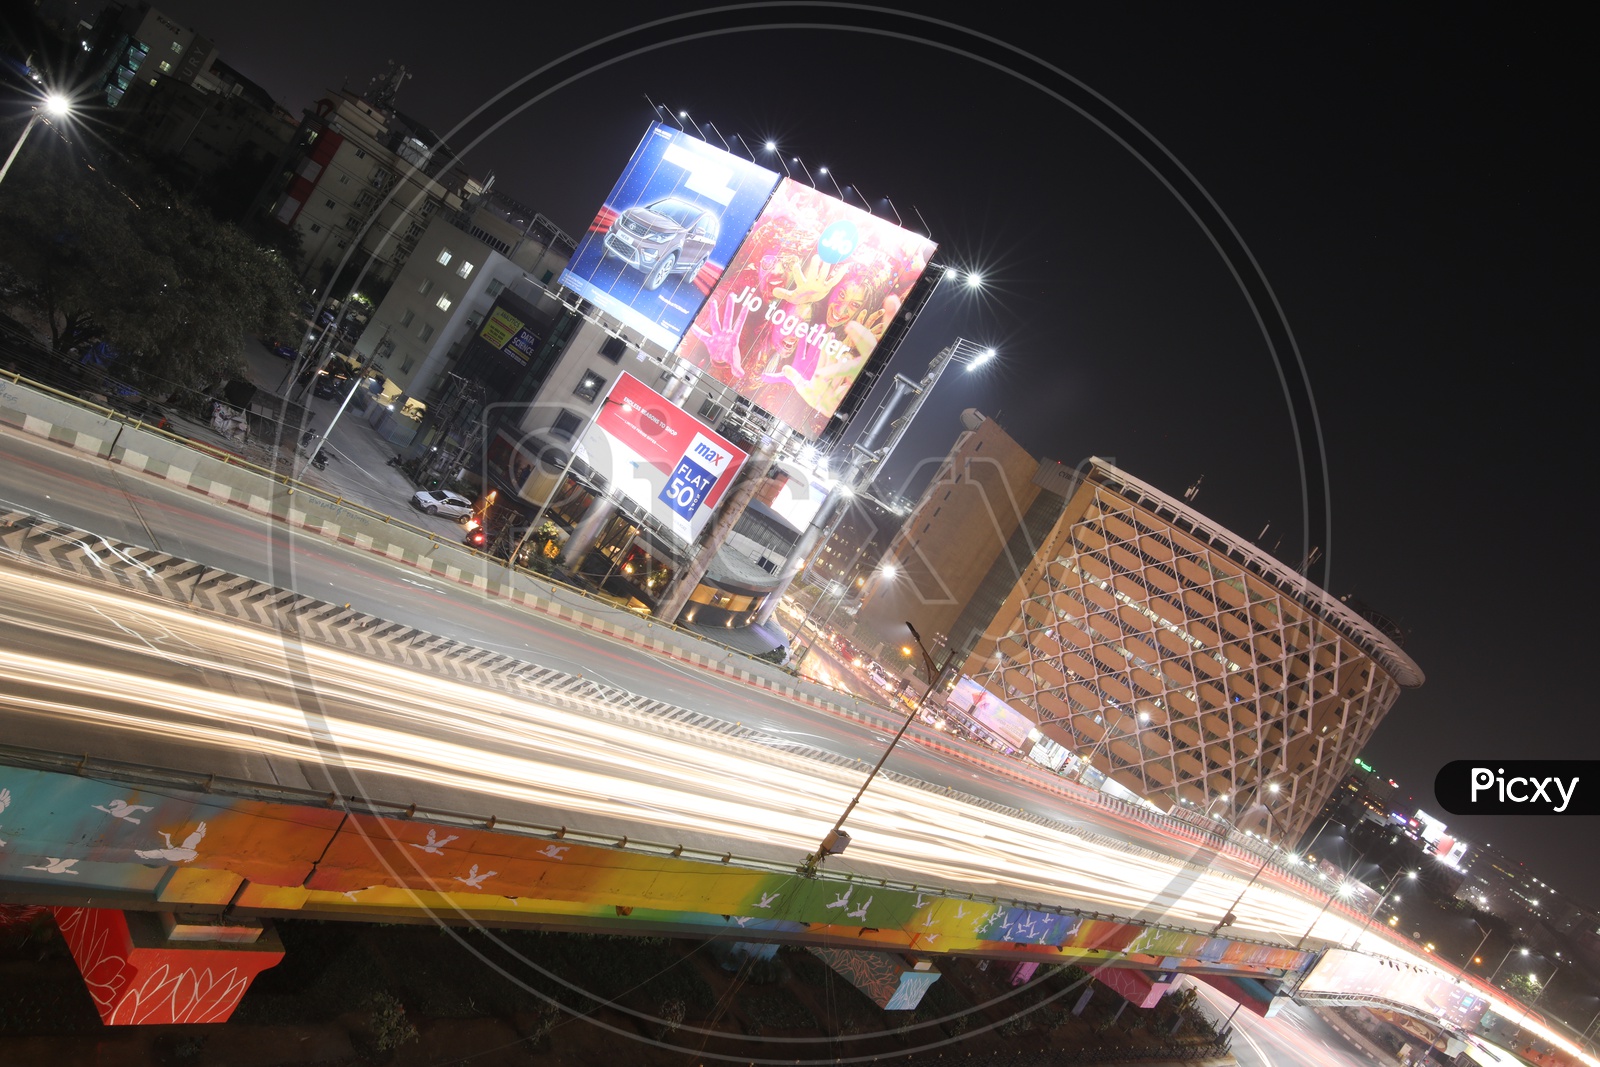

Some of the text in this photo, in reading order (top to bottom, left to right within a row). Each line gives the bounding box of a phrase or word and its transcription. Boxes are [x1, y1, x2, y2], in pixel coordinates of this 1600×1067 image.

[179, 46, 205, 80] URY
[821, 229, 853, 255] Jio
[521, 331, 535, 346] DATA
[734, 286, 763, 312] Jio
[764, 301, 852, 363] together.
[512, 337, 534, 356] SCIENCE
[623, 396, 678, 437] ENDLESS REASONS TO SHOP
[694, 442, 724, 466] max
[677, 463, 710, 491] FLAT
[666, 477, 694, 507] 50
